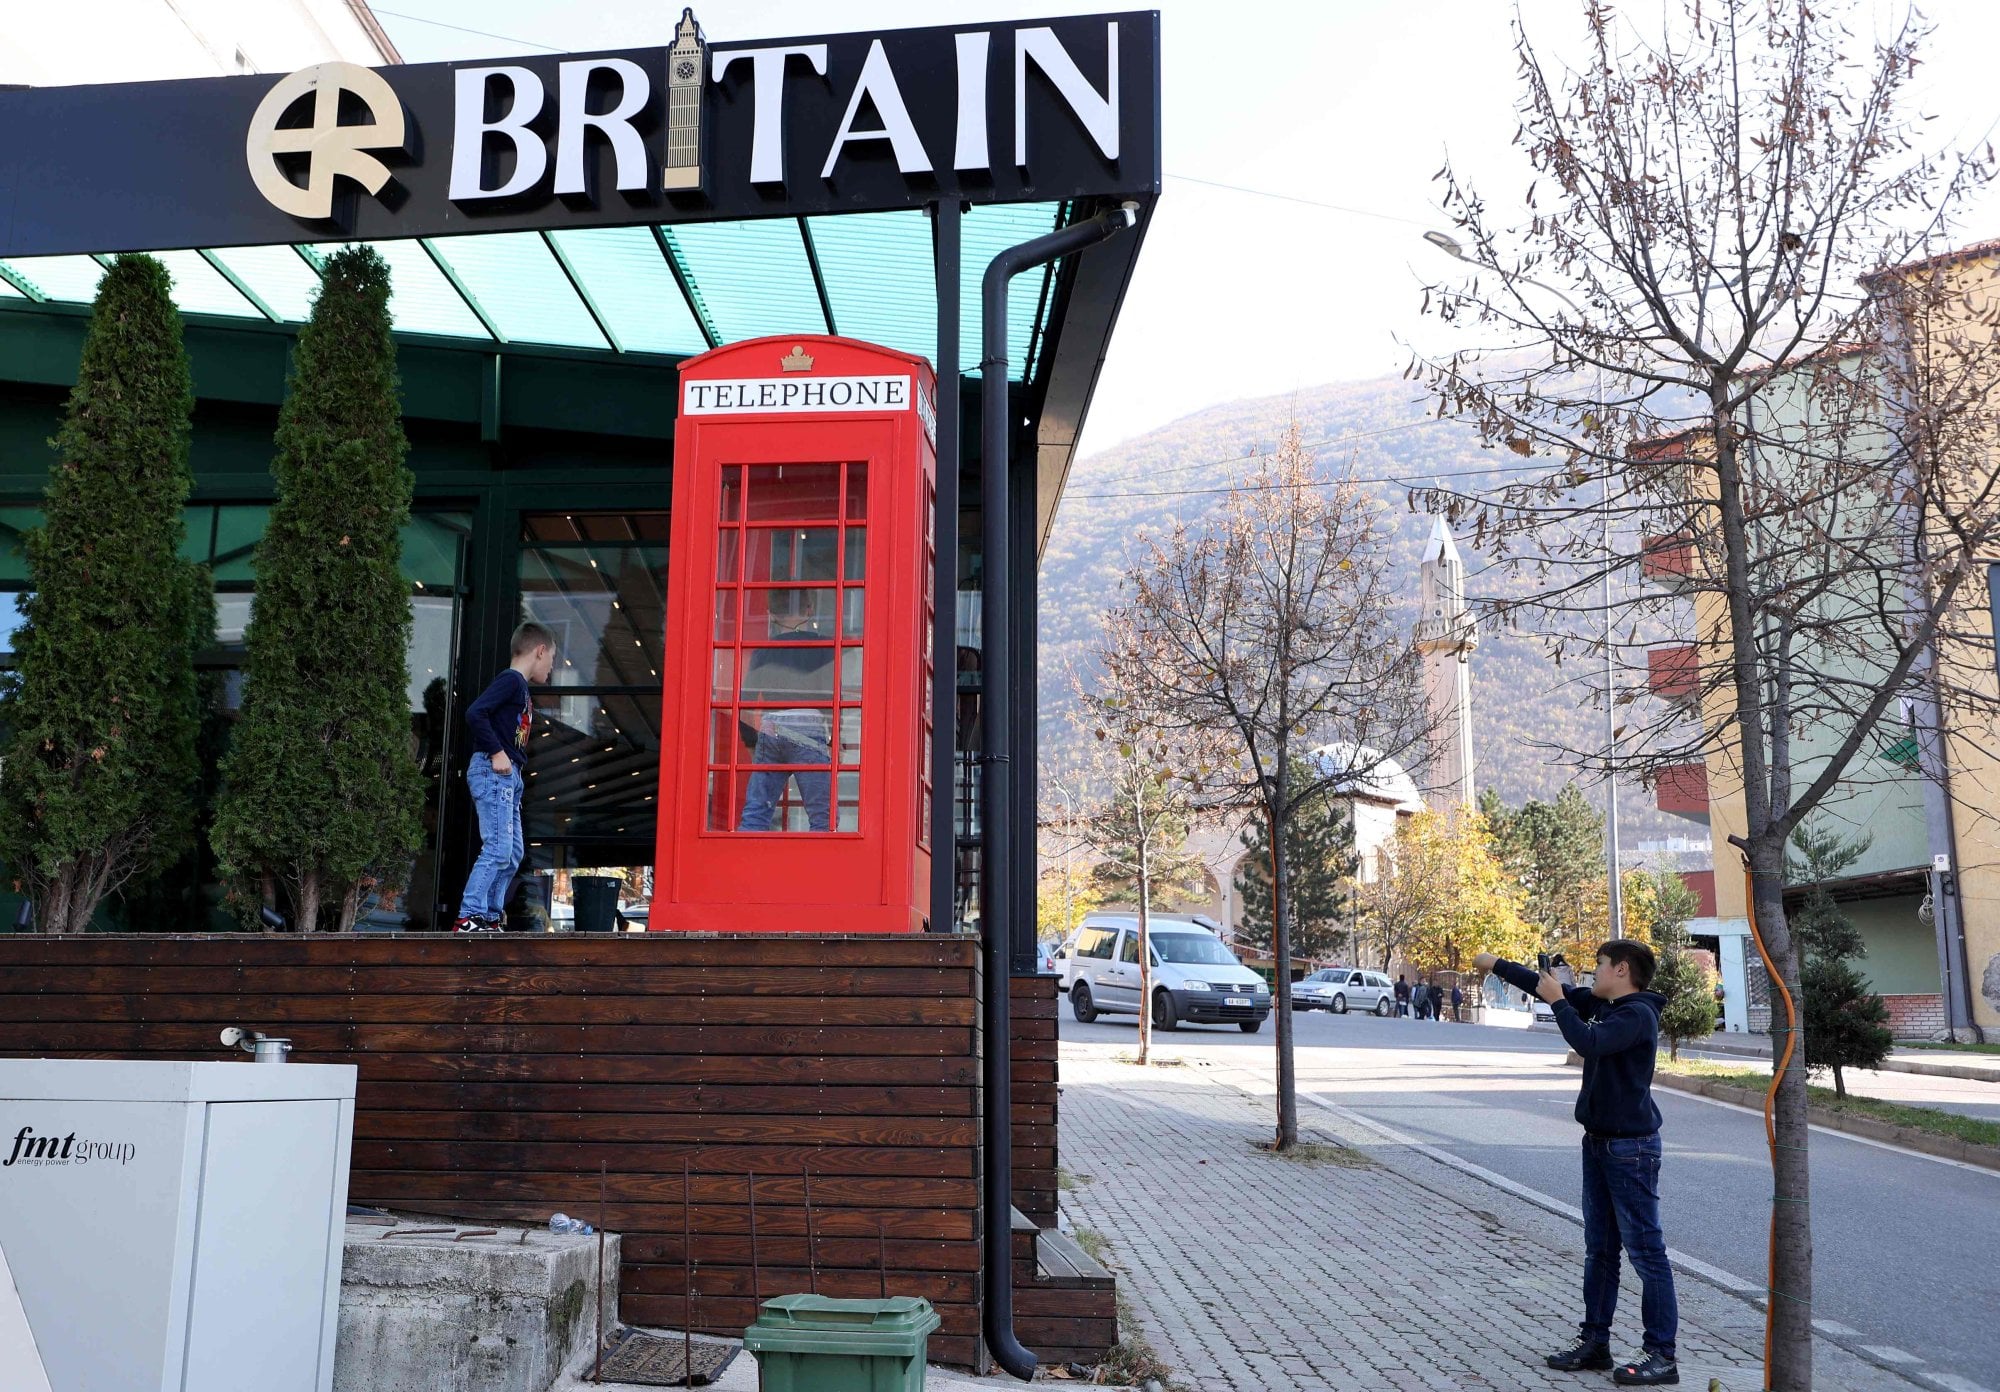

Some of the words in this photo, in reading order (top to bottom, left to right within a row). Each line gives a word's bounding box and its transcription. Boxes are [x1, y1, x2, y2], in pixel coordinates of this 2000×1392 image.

[448, 8, 1120, 201] BRITAIN
[691, 380, 904, 409] TELEPHONE
[17, 1158, 42, 1167] energy
